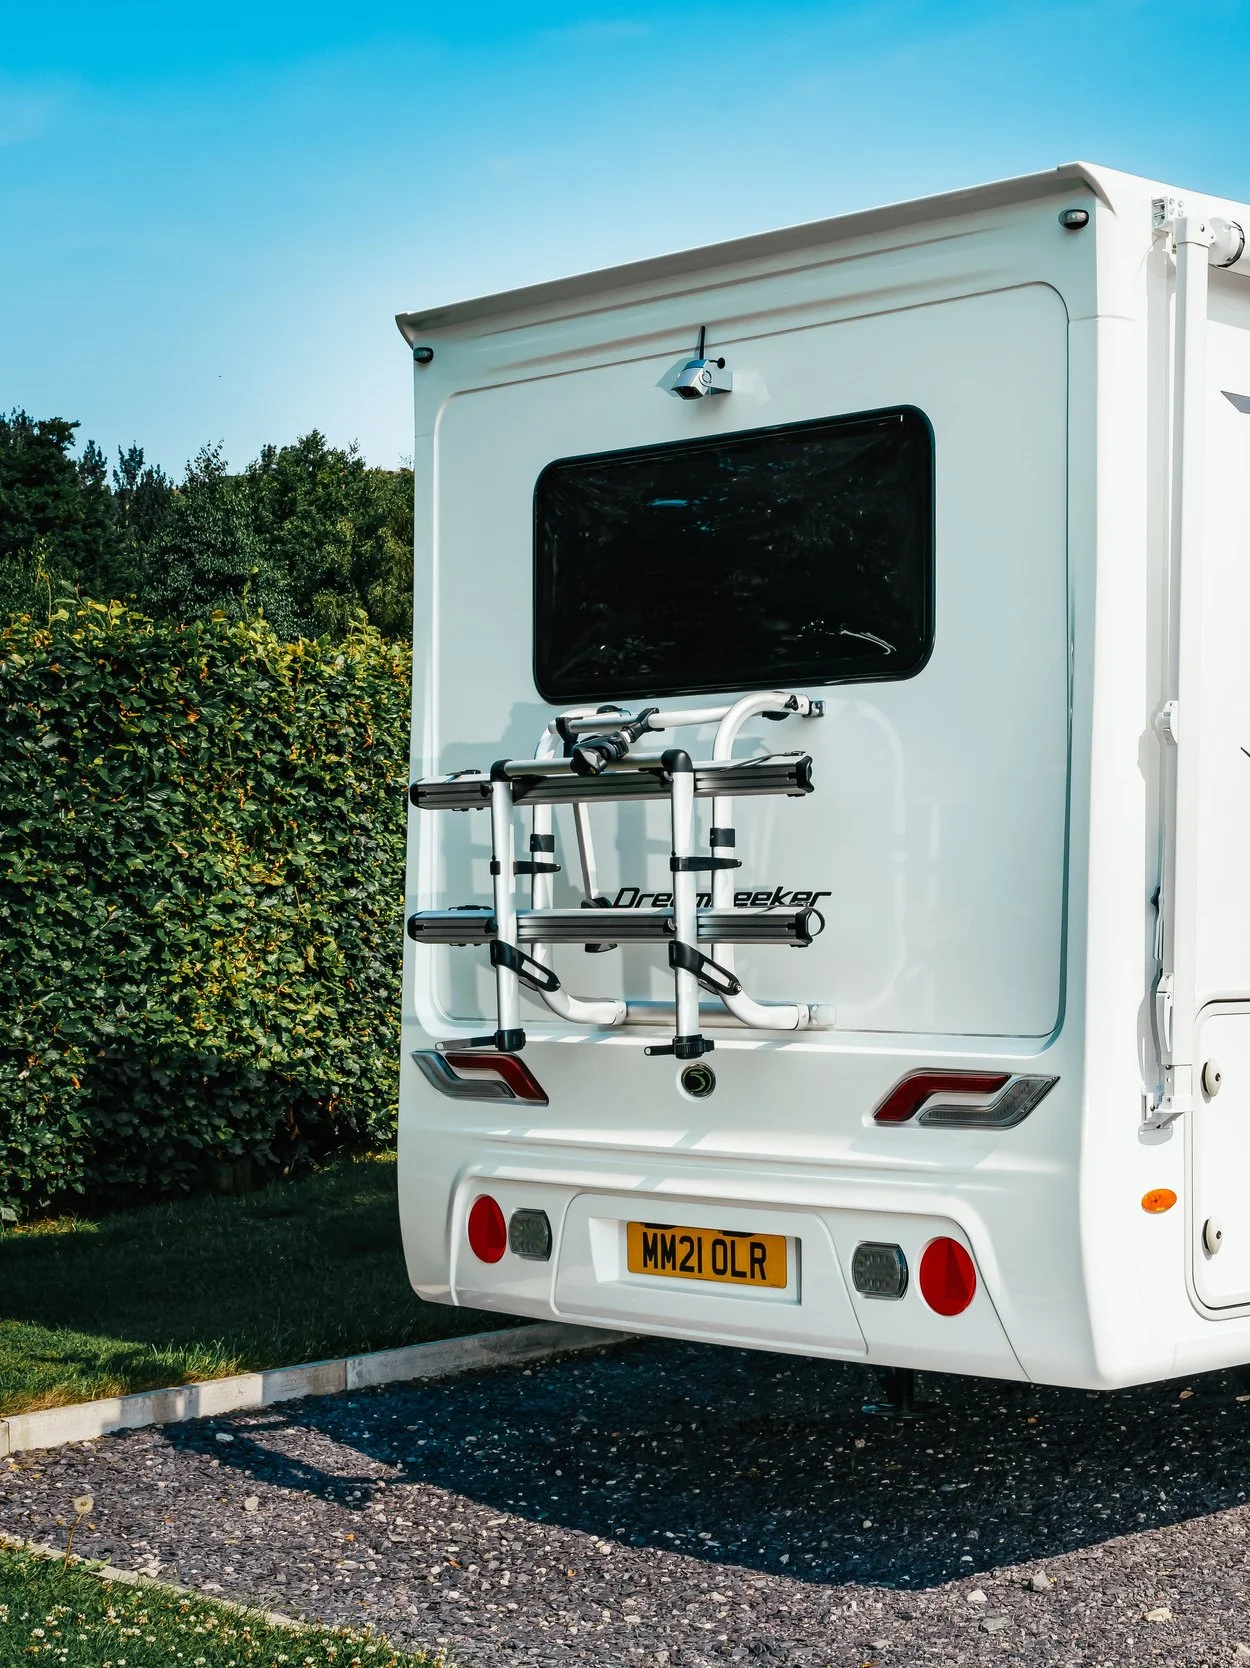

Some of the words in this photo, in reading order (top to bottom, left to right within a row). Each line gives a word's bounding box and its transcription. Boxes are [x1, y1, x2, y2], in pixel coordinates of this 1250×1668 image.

[612, 886, 832, 908] Dremeeker
[642, 1231, 703, 1274] MM21
[711, 1238, 767, 1281] OLR
